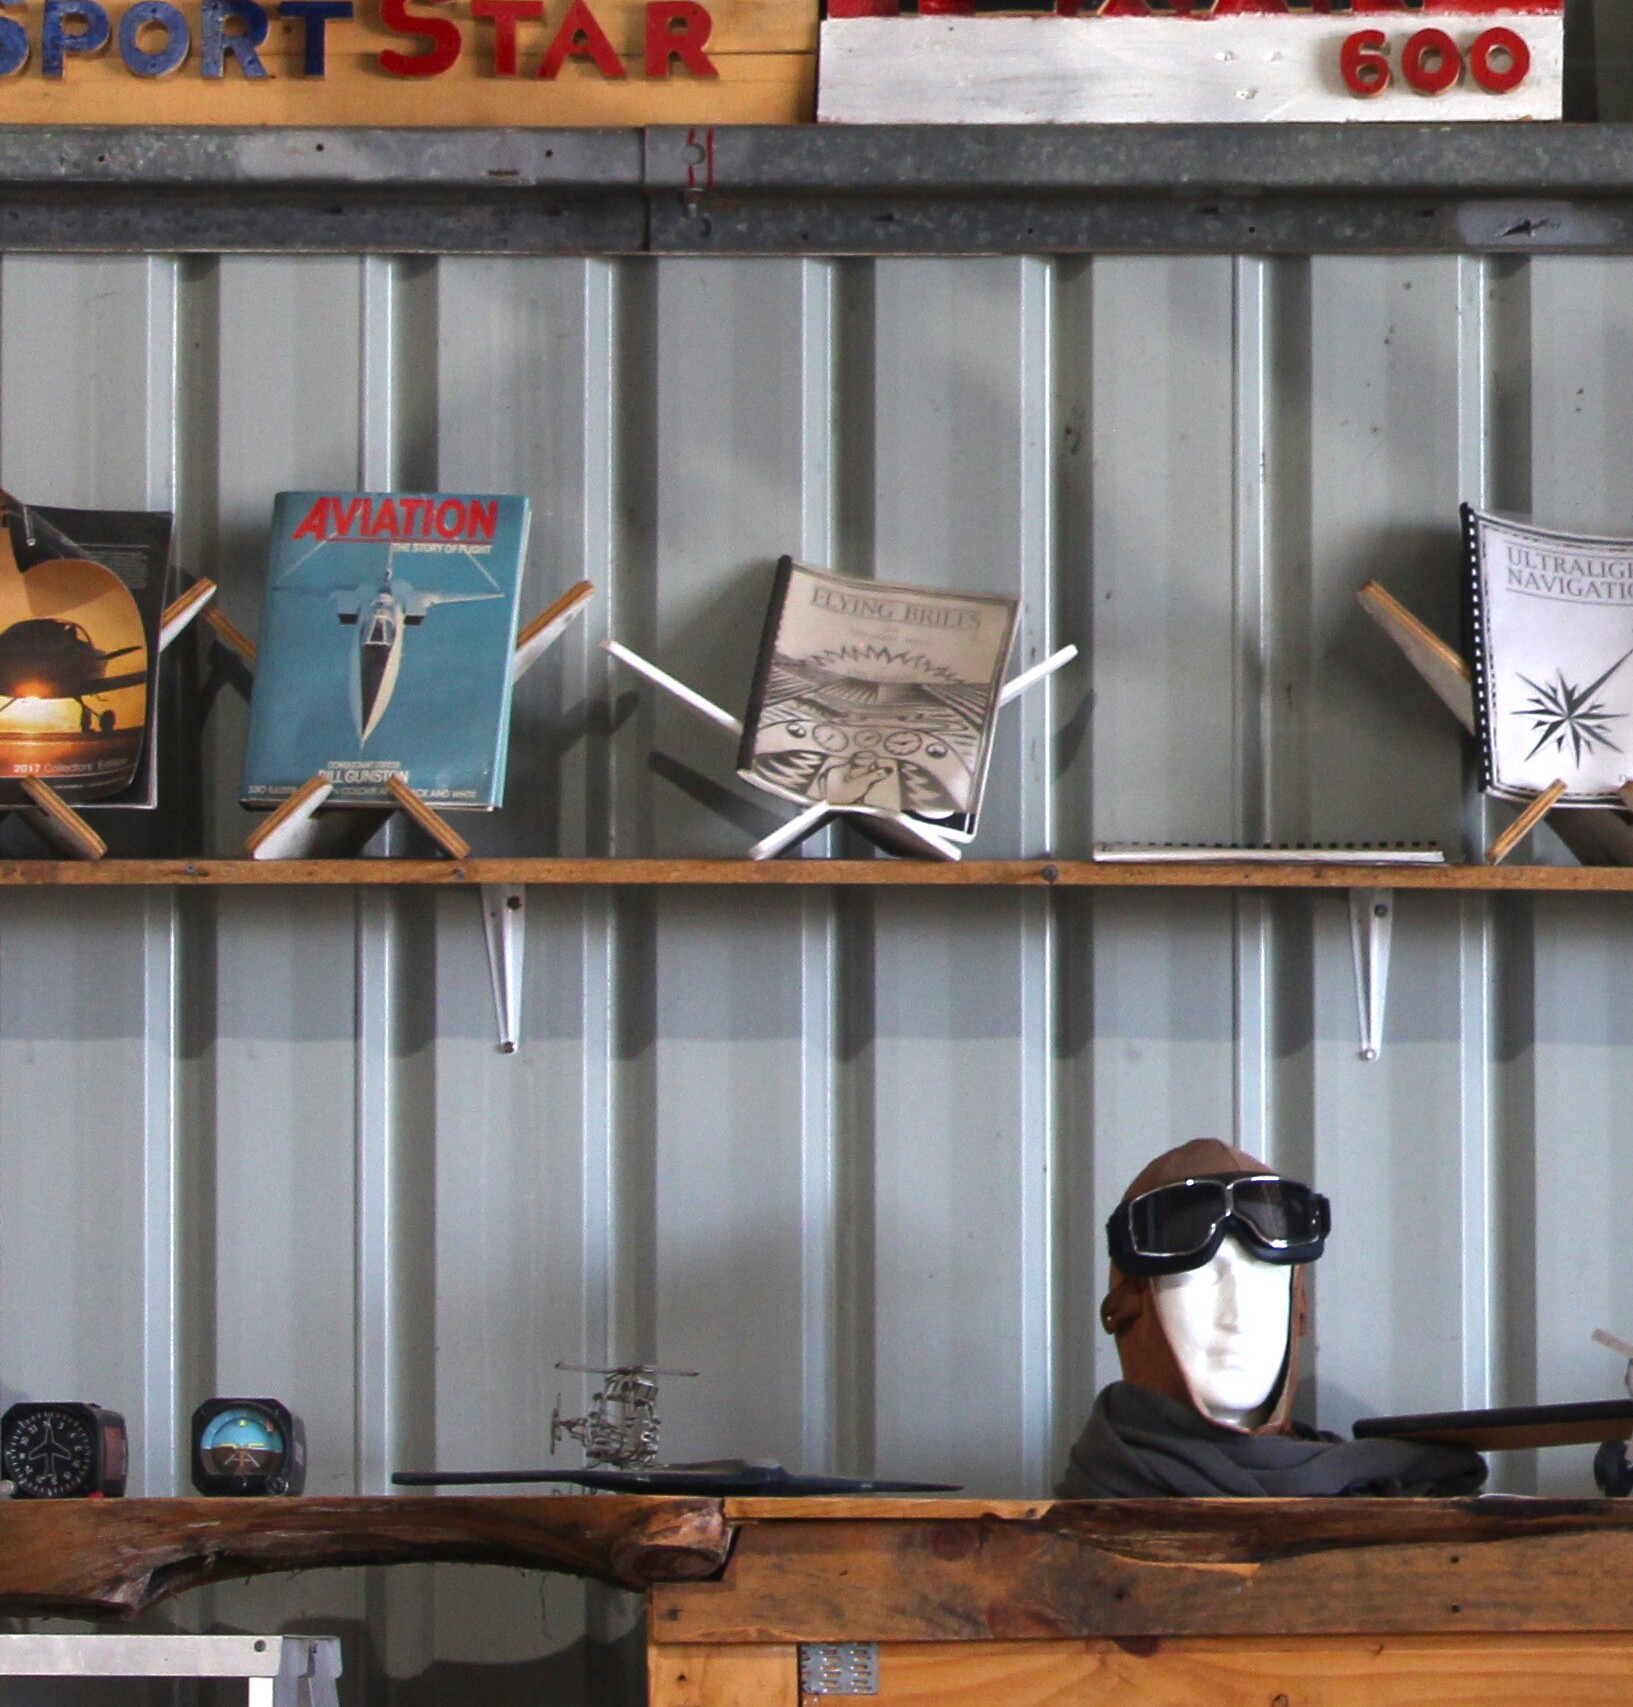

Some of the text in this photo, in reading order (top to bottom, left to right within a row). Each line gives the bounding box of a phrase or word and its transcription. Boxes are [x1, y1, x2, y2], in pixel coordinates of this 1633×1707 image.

[1339, 26, 1531, 98] 600
[292, 495, 499, 541] AVIATION
[14, 763, 41, 773] 2017
